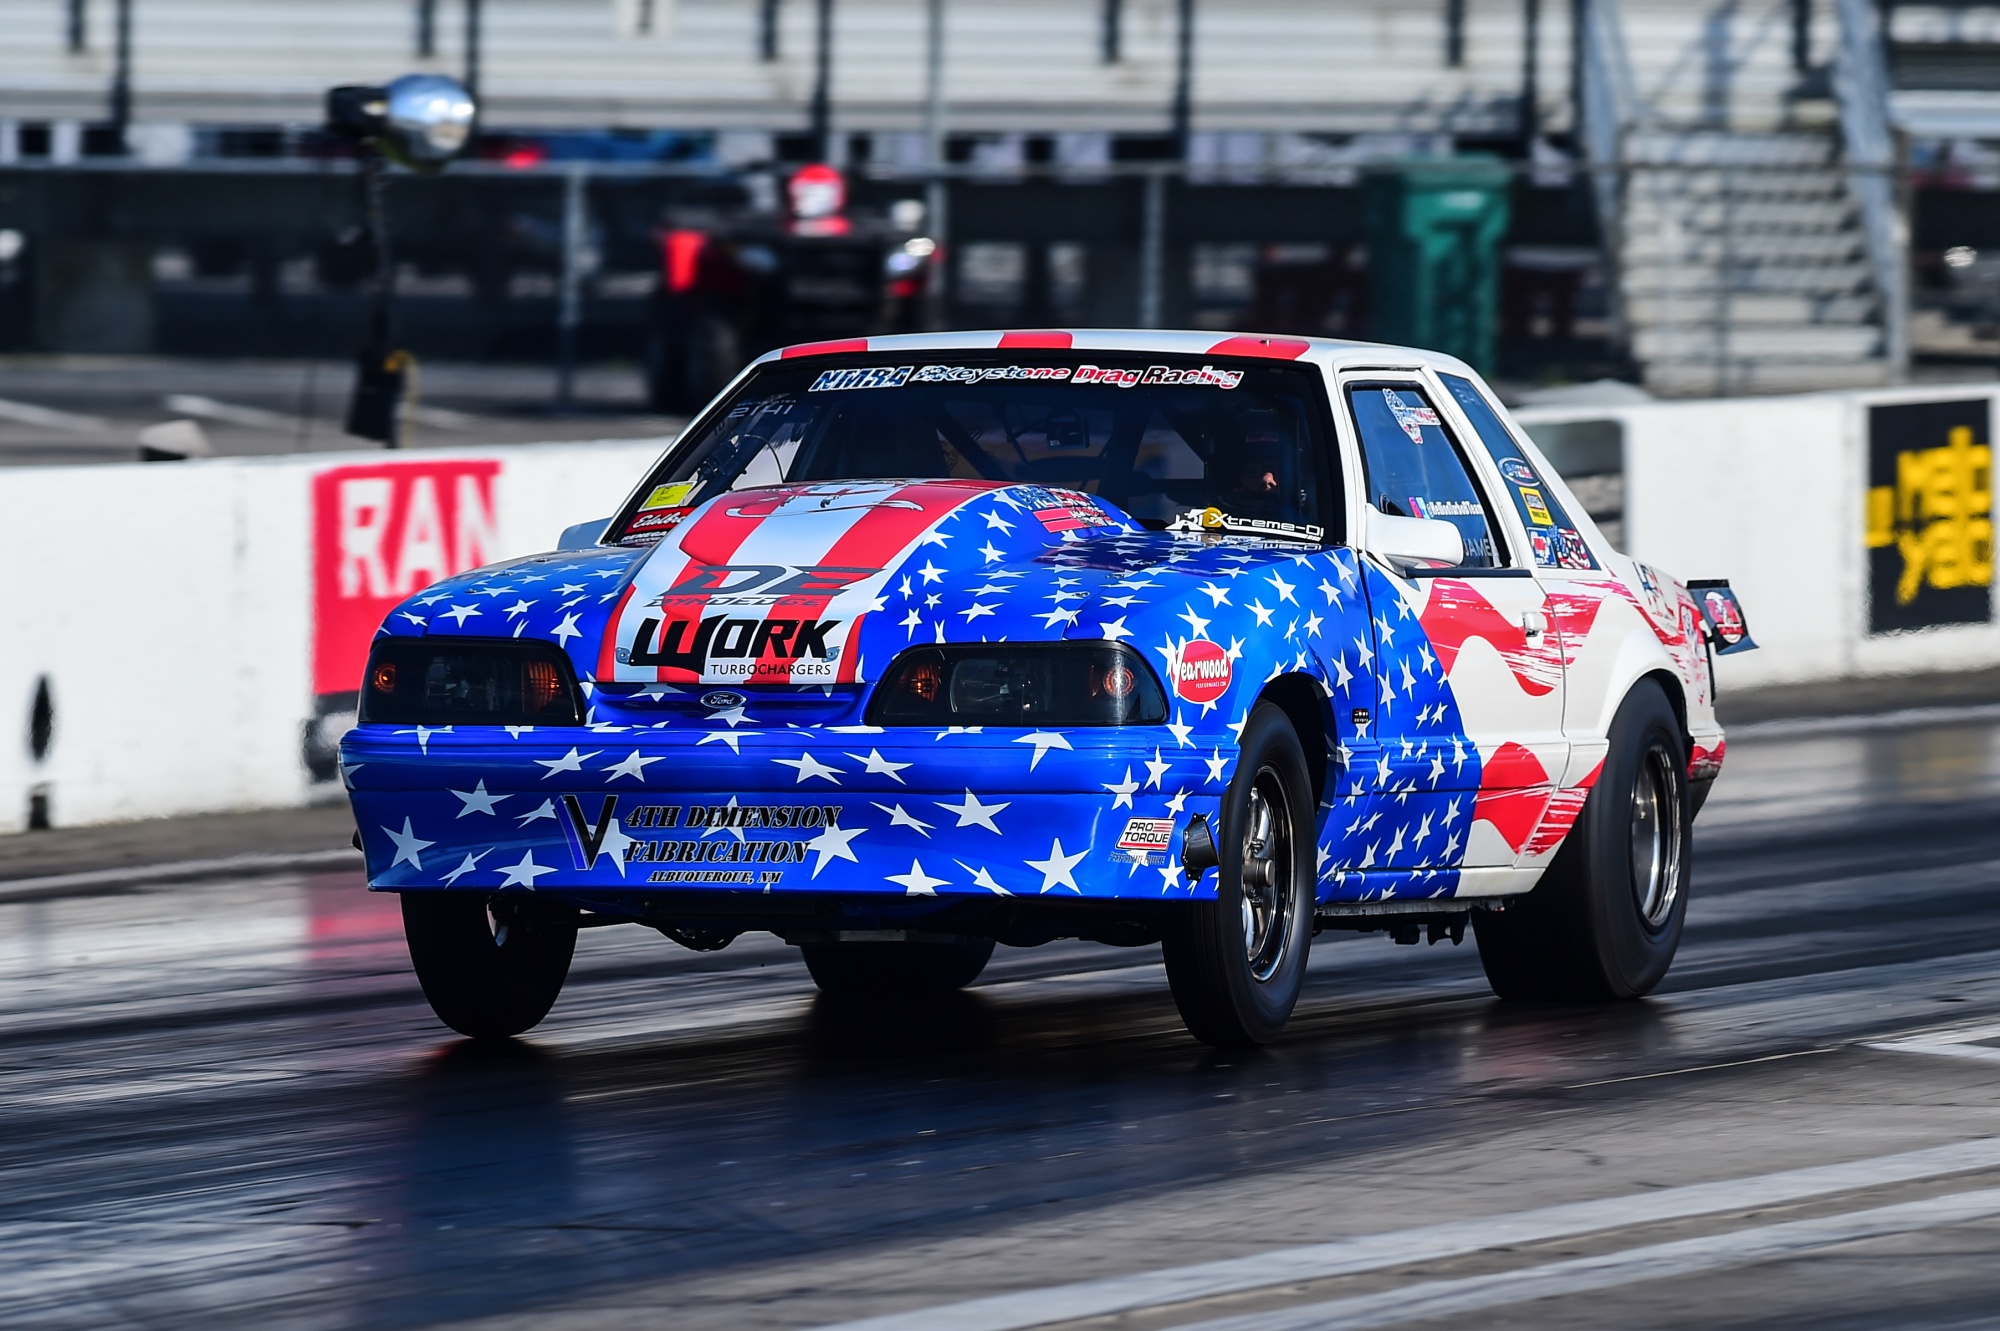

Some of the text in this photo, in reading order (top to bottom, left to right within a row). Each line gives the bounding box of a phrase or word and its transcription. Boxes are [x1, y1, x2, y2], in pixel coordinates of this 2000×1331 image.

[808, 365, 1244, 392] NMRA Keystone Drag Racing
[728, 404, 793, 418] 2141
[629, 613, 843, 676] WORK
[711, 664, 831, 676] TURBOCHARGERS
[1171, 635, 1229, 698] Yearwood
[710, 694, 735, 705] Ford
[625, 806, 843, 828] 4TH DIMENSION
[1129, 822, 1154, 832] PRO
[1124, 832, 1170, 843] TORQUE
[623, 841, 811, 863] FABRICATION
[757, 871, 783, 884] NM
